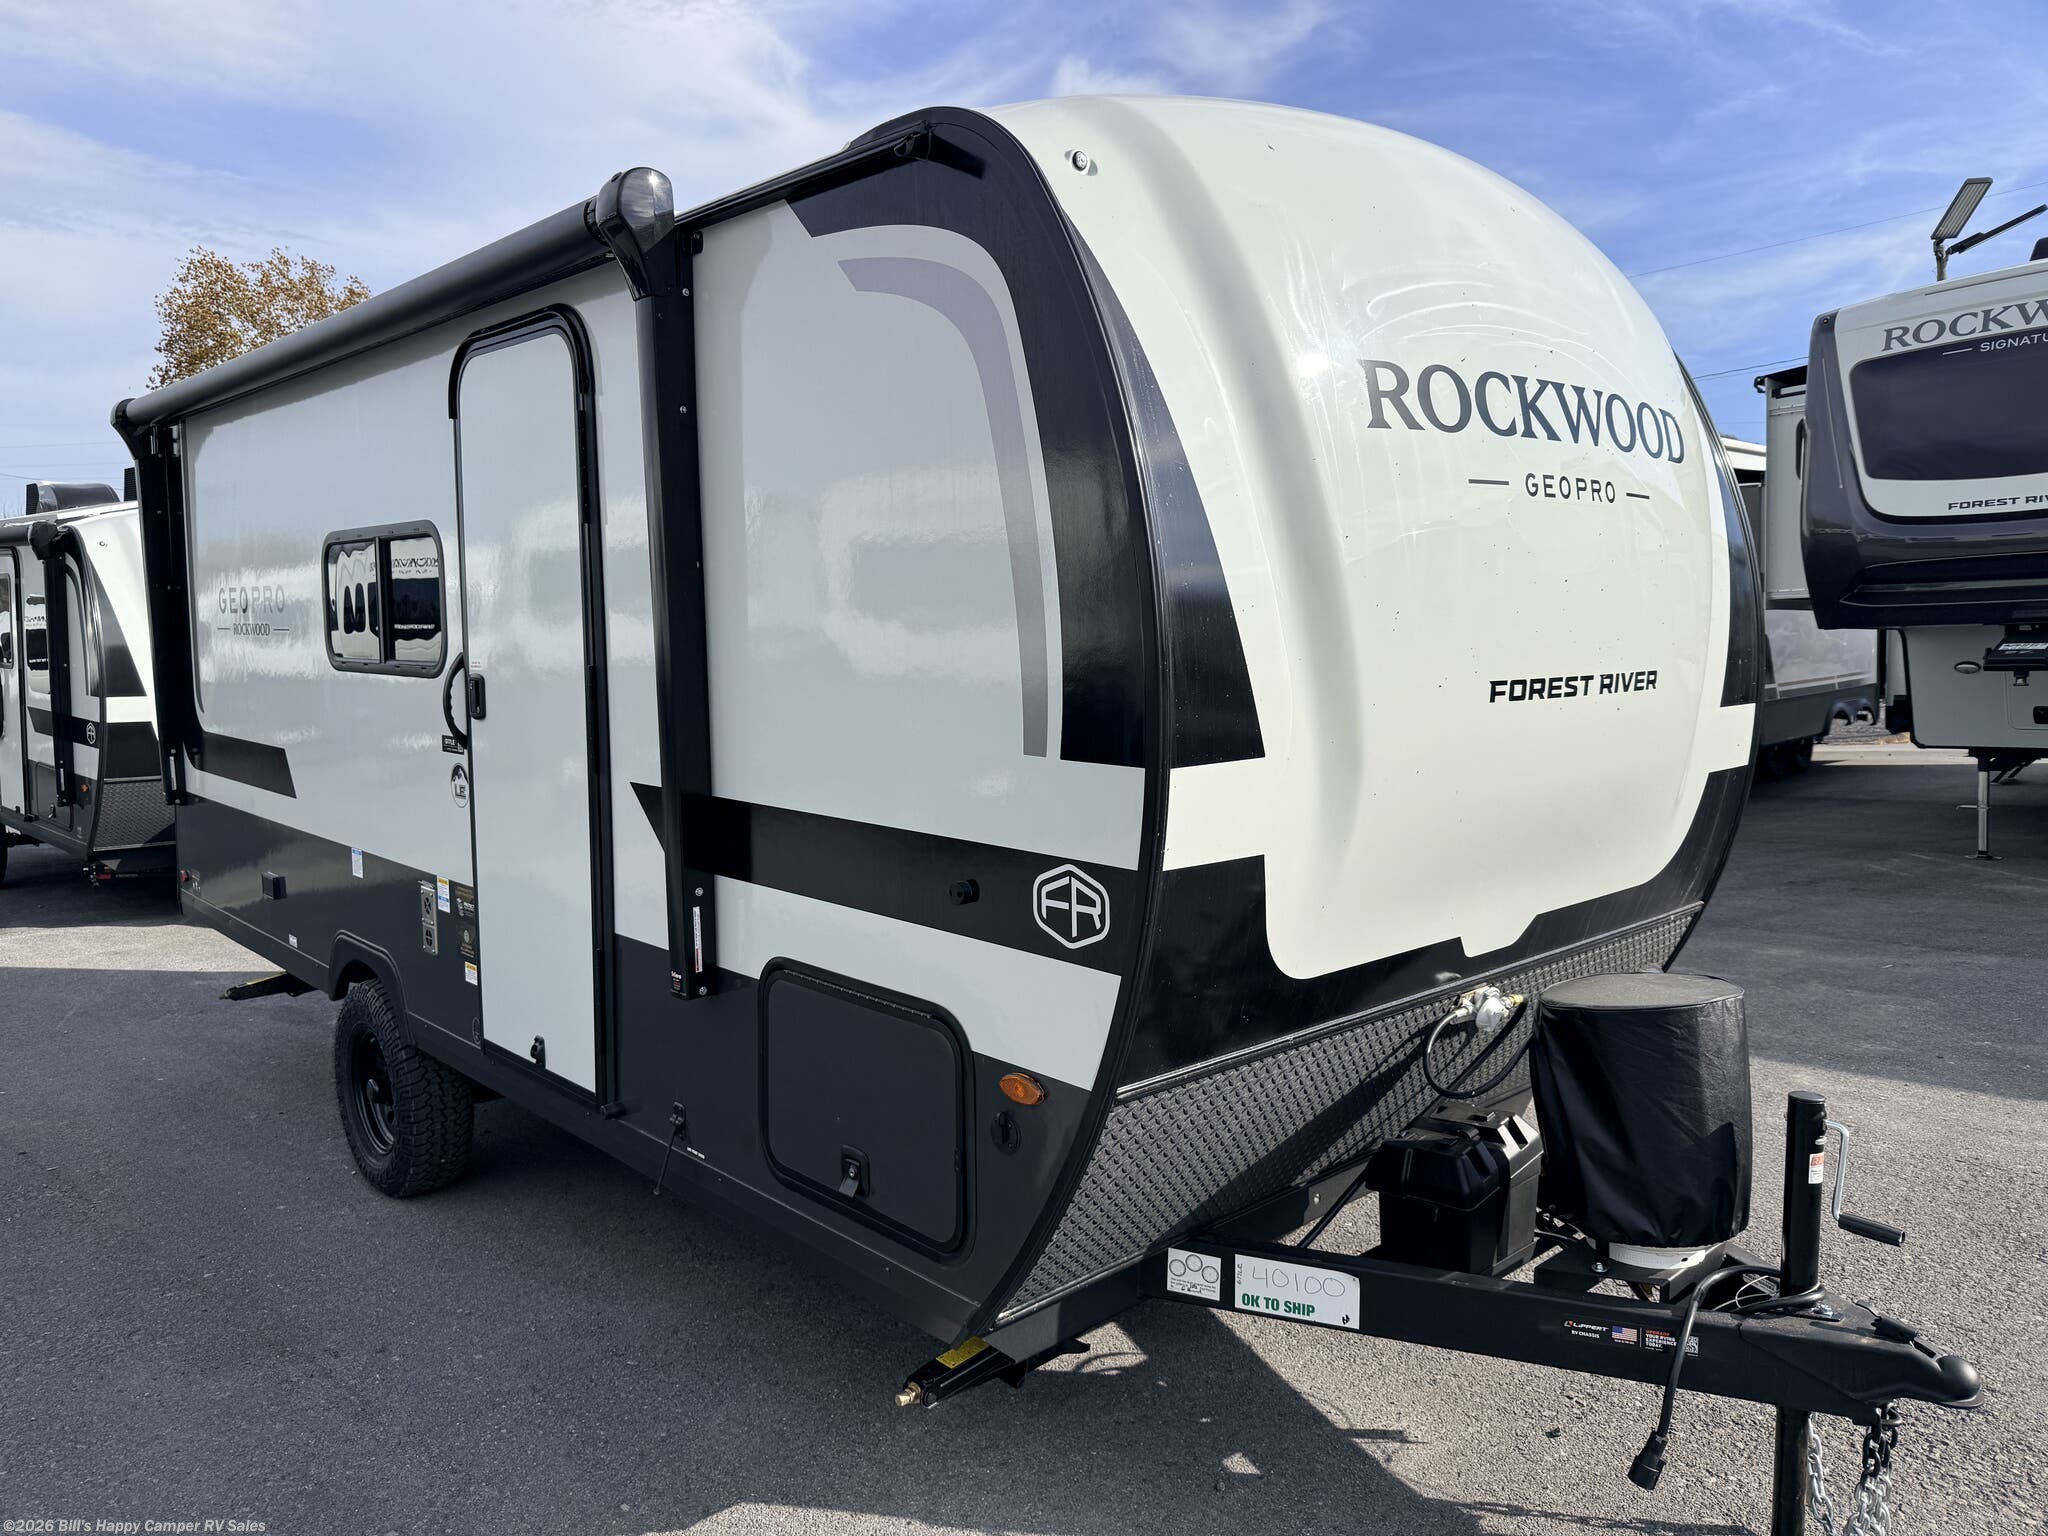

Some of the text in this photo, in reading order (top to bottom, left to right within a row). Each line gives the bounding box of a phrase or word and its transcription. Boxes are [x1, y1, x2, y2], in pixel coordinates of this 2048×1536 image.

[1358, 359, 1685, 464] ROCKWOOD
[1525, 473, 1616, 503] GEOPRO
[1948, 497, 2021, 511] FOREST
[233, 622, 271, 636] ROCKWOOD
[1489, 670, 1658, 703] FOREST RIVER
[1252, 1266, 1346, 1297] 40100
[1241, 1292, 1316, 1317] OK TO SHIP
